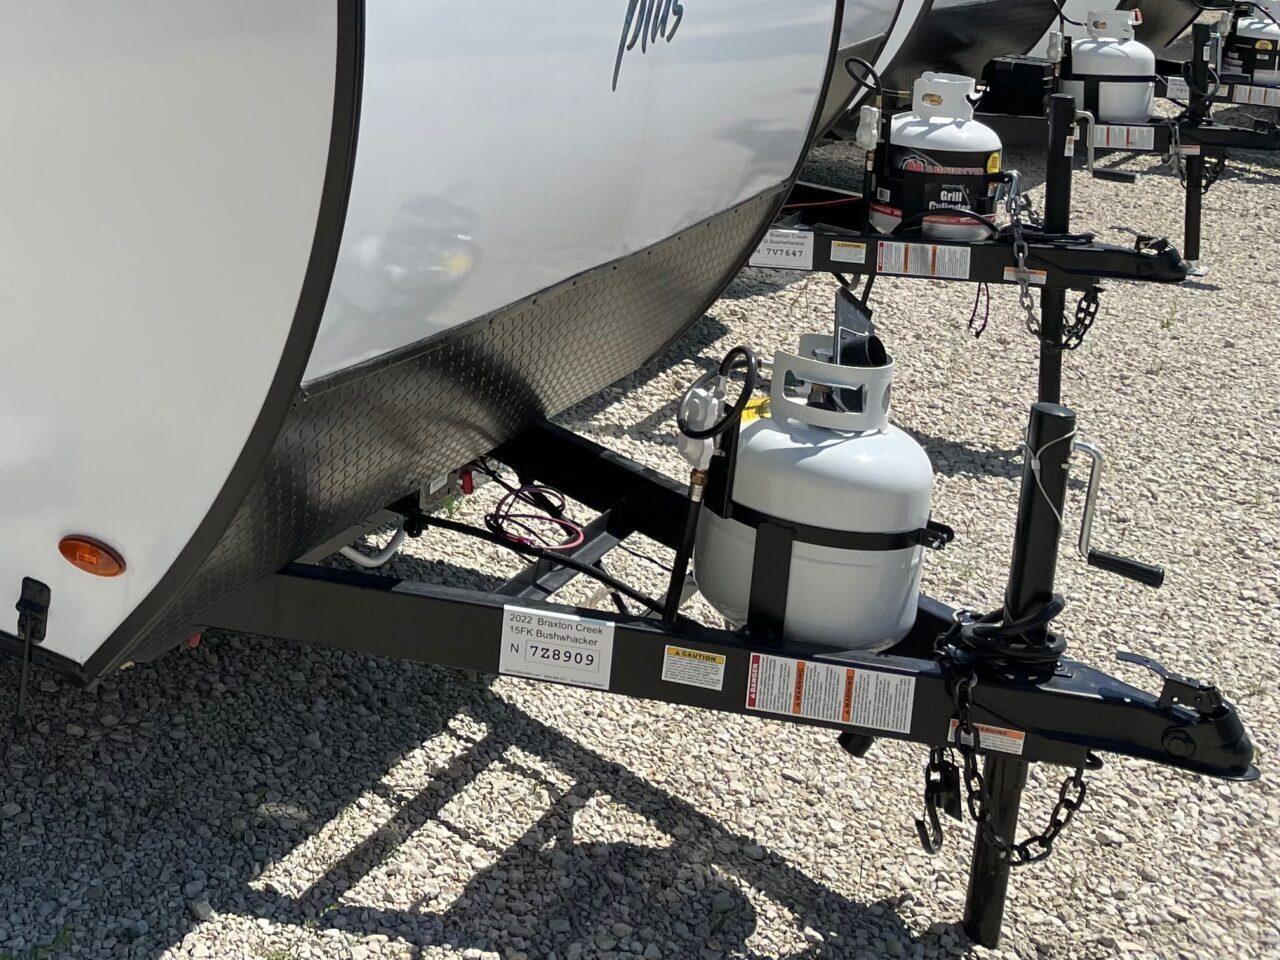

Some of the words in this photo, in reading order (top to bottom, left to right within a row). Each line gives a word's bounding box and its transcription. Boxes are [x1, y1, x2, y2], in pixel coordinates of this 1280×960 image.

[940, 190, 963, 202] Grill
[509, 625, 533, 637] 15FK
[535, 629, 598, 646] Bushwhacker
[510, 613, 533, 625] 2022
[537, 617, 573, 631] Braxton
[575, 623, 604, 636] Creek
[510, 643, 520, 654] N
[530, 645, 594, 666] 7Z8909
[682, 650, 717, 662] CAUTION
[750, 663, 759, 693] DANGER
[844, 675, 853, 709] WARNING
[979, 725, 1008, 737] ARNING
